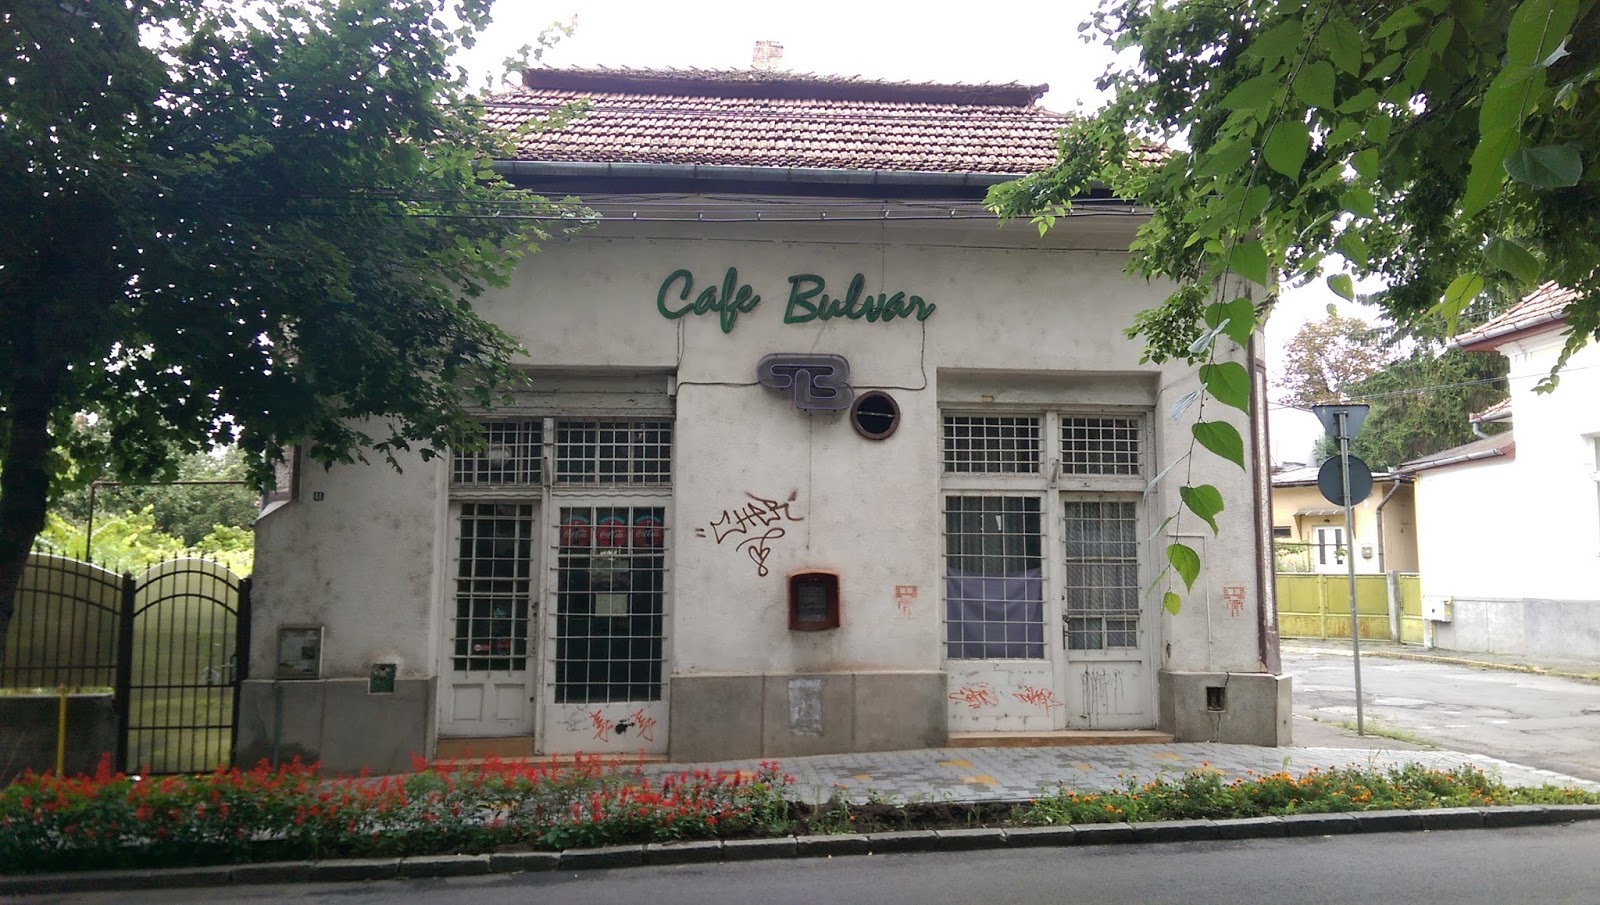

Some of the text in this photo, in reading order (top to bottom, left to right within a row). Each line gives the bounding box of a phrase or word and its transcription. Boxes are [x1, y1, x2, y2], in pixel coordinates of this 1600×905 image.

[657, 267, 937, 334] Cafe Bulvar
[563, 529, 588, 539] Coa-Cola
